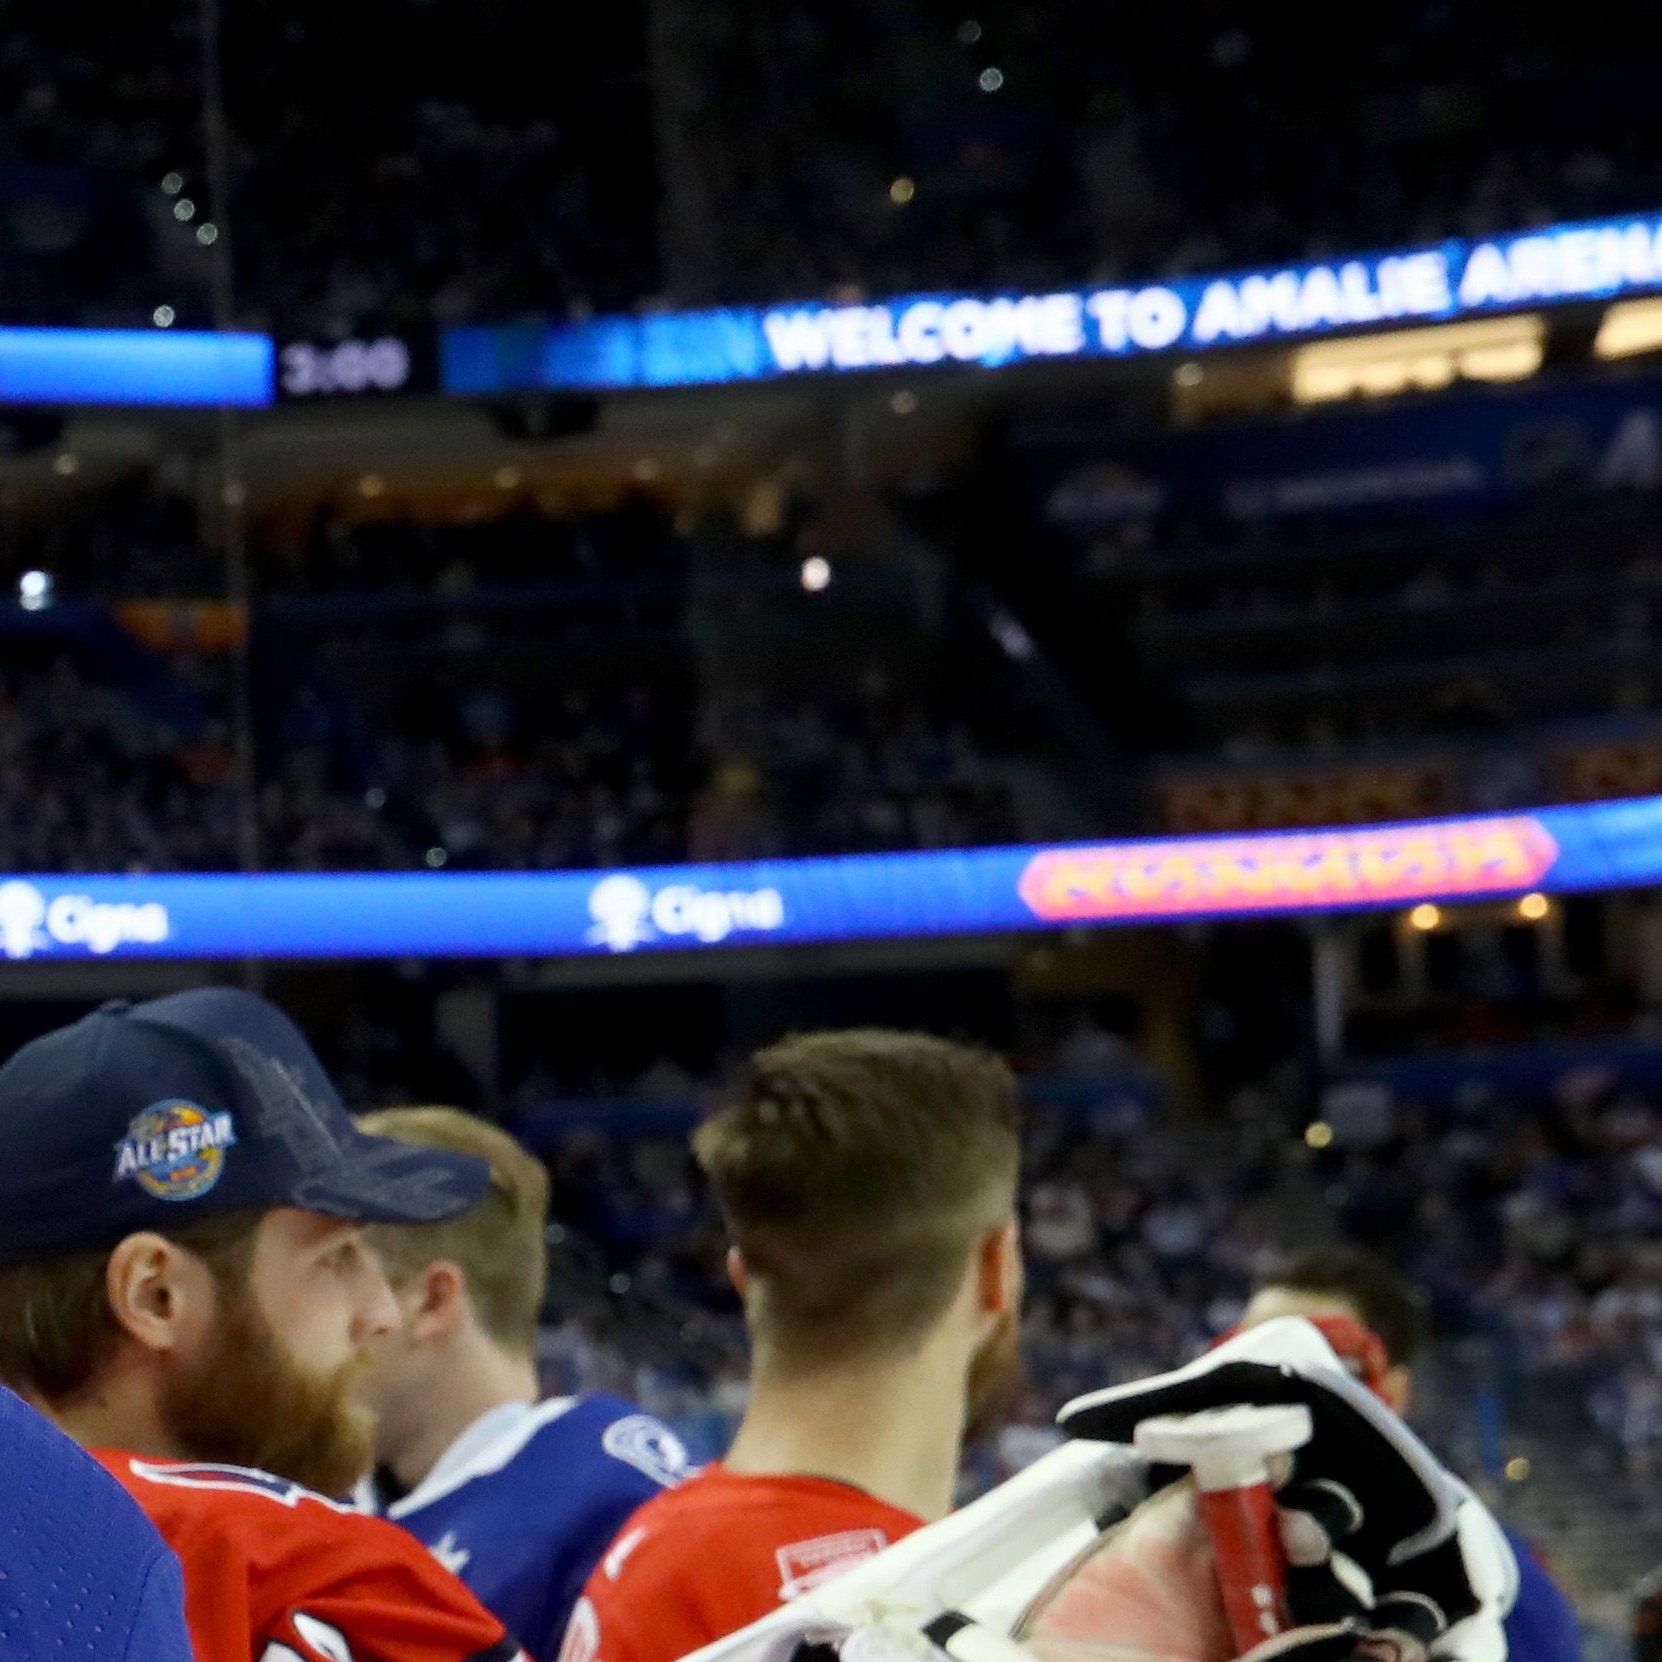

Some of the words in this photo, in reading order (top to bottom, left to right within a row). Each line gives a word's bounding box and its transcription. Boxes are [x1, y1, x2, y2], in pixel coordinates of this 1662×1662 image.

[763, 293, 1084, 371] WELCOME
[1087, 287, 1187, 350] TO
[1193, 251, 1451, 343] AMALIE
[1459, 219, 1662, 307] AREN
[47, 894, 168, 954] Cigna
[652, 884, 783, 943] Cigna
